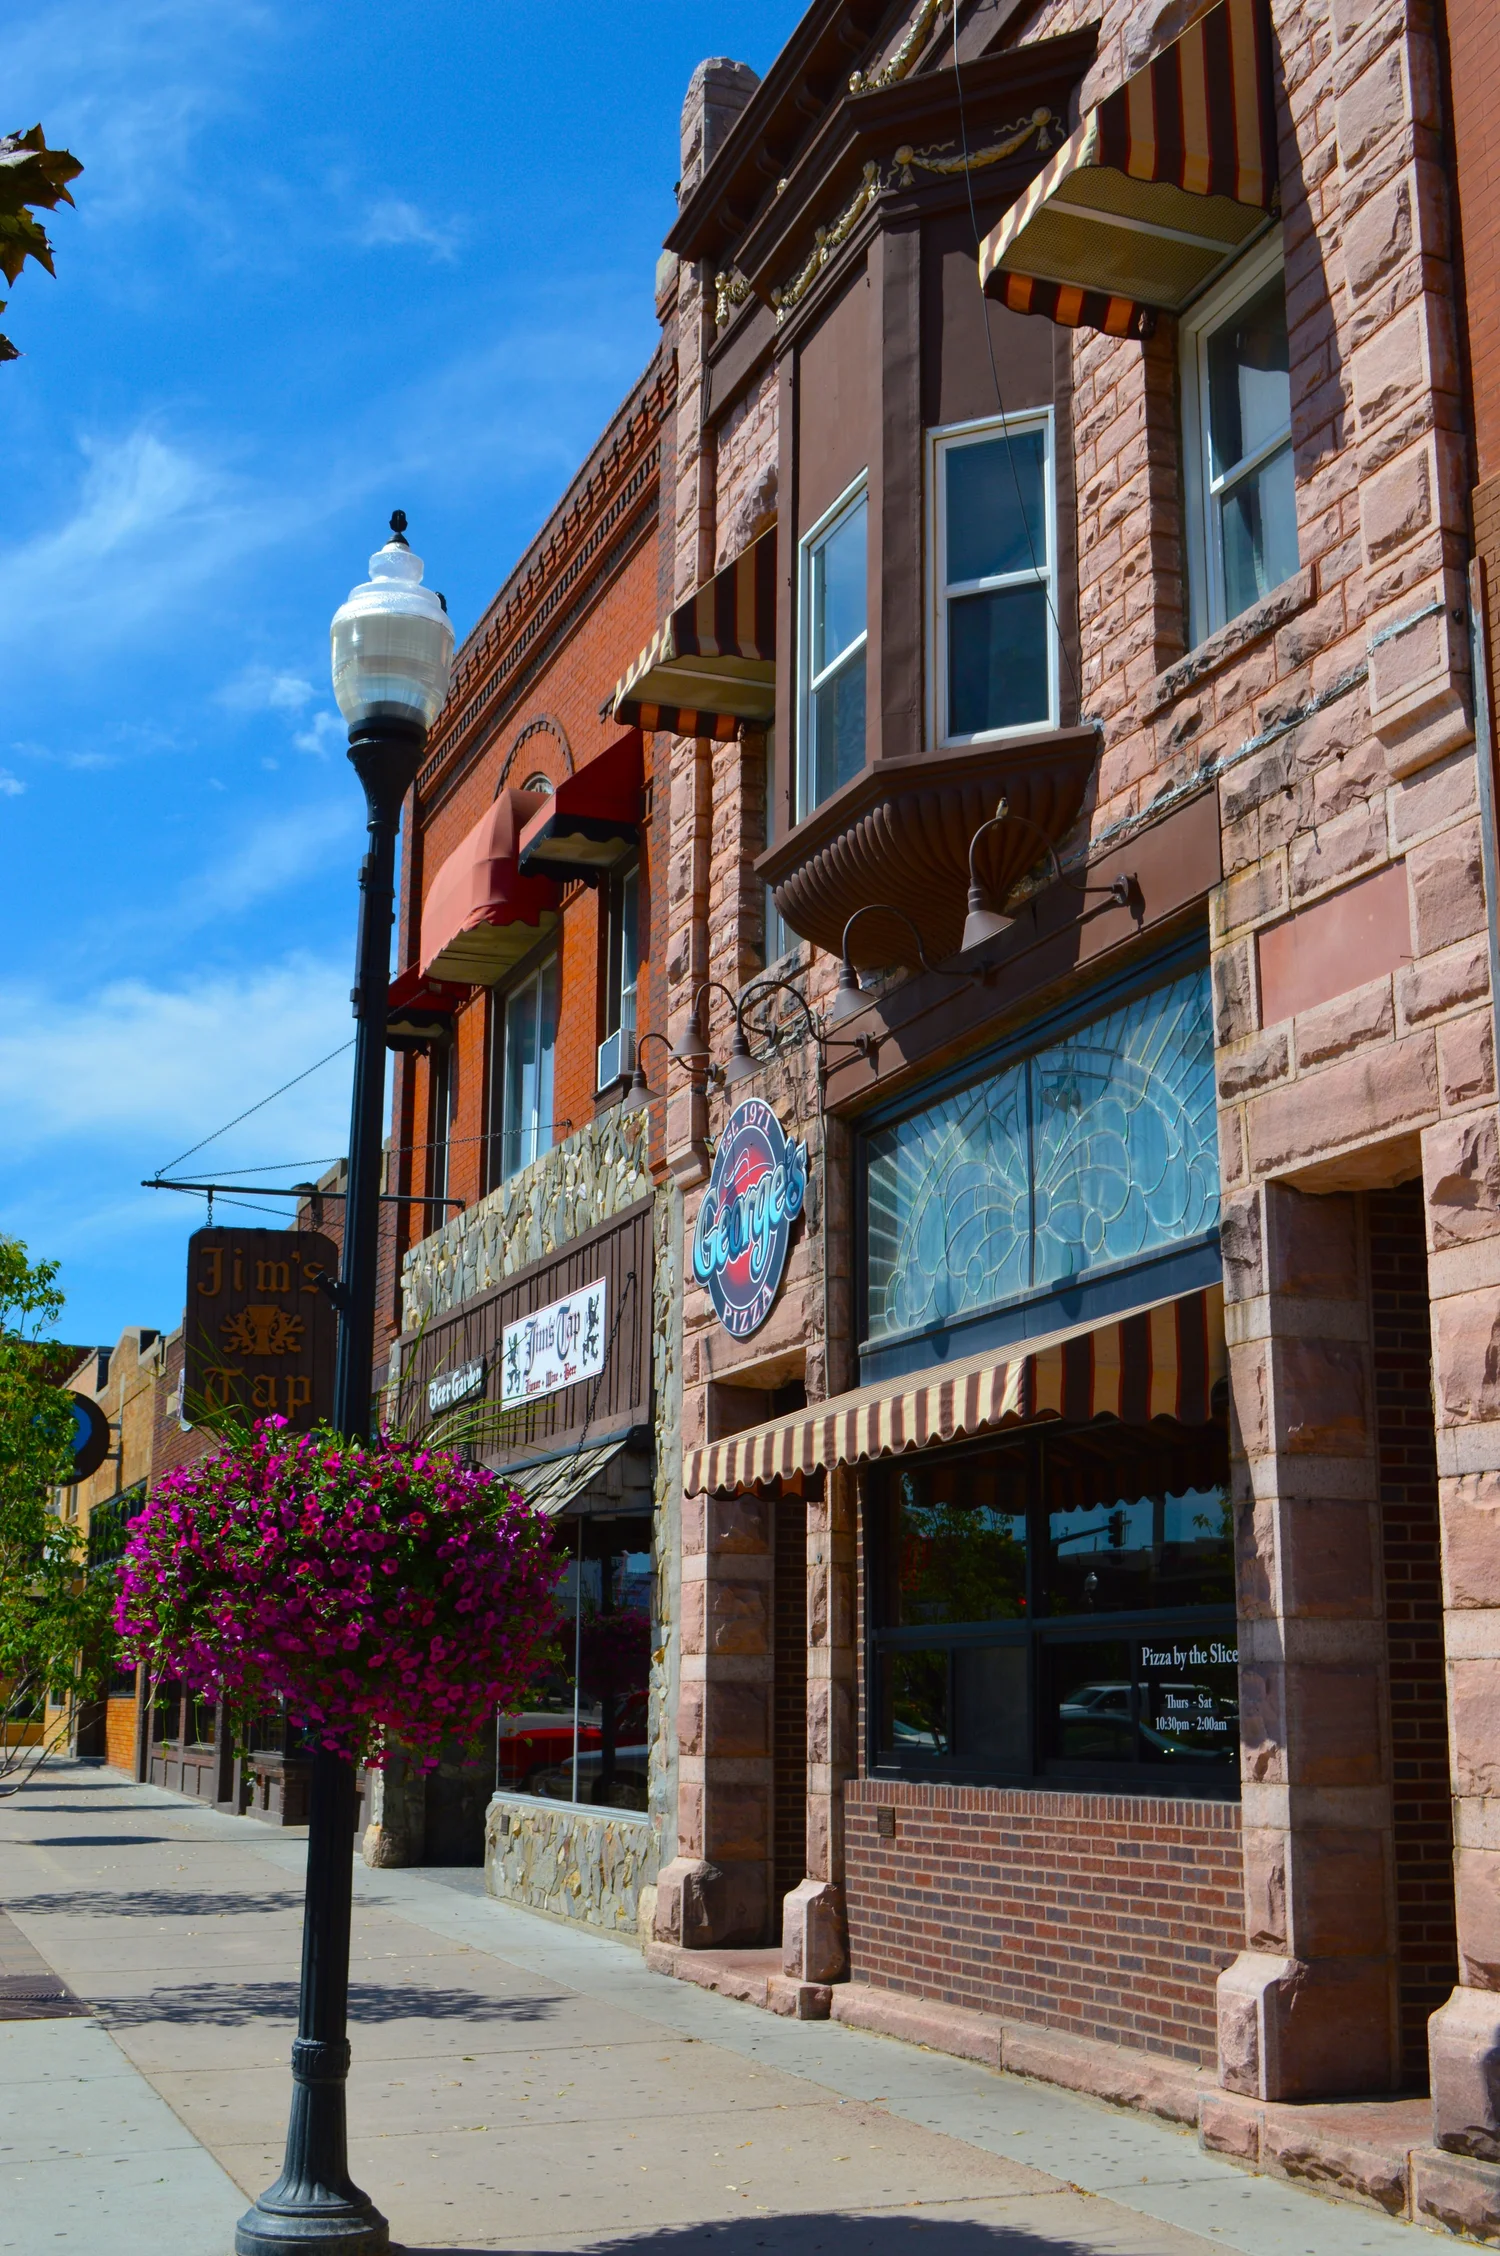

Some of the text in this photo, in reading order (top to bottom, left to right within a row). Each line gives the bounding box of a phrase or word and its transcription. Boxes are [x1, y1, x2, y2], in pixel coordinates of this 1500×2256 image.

[720, 1103, 771, 1156] Est 1971
[693, 1137, 807, 1280] George's
[197, 1247, 326, 1297] Jim's
[721, 1283, 774, 1333] PIZZA
[523, 1301, 581, 1377] Jim's Tap
[203, 1367, 313, 1420] Tap
[429, 1364, 482, 1411] Beer Garden
[1141, 1642, 1239, 1671] Pizza by the Slice
[1155, 1717, 1190, 1735] 10:30pm
[1197, 1716, 1227, 1731] 2:00am
[1165, 1694, 1189, 1709] Thurs
[1198, 1693, 1212, 1709] Sat
